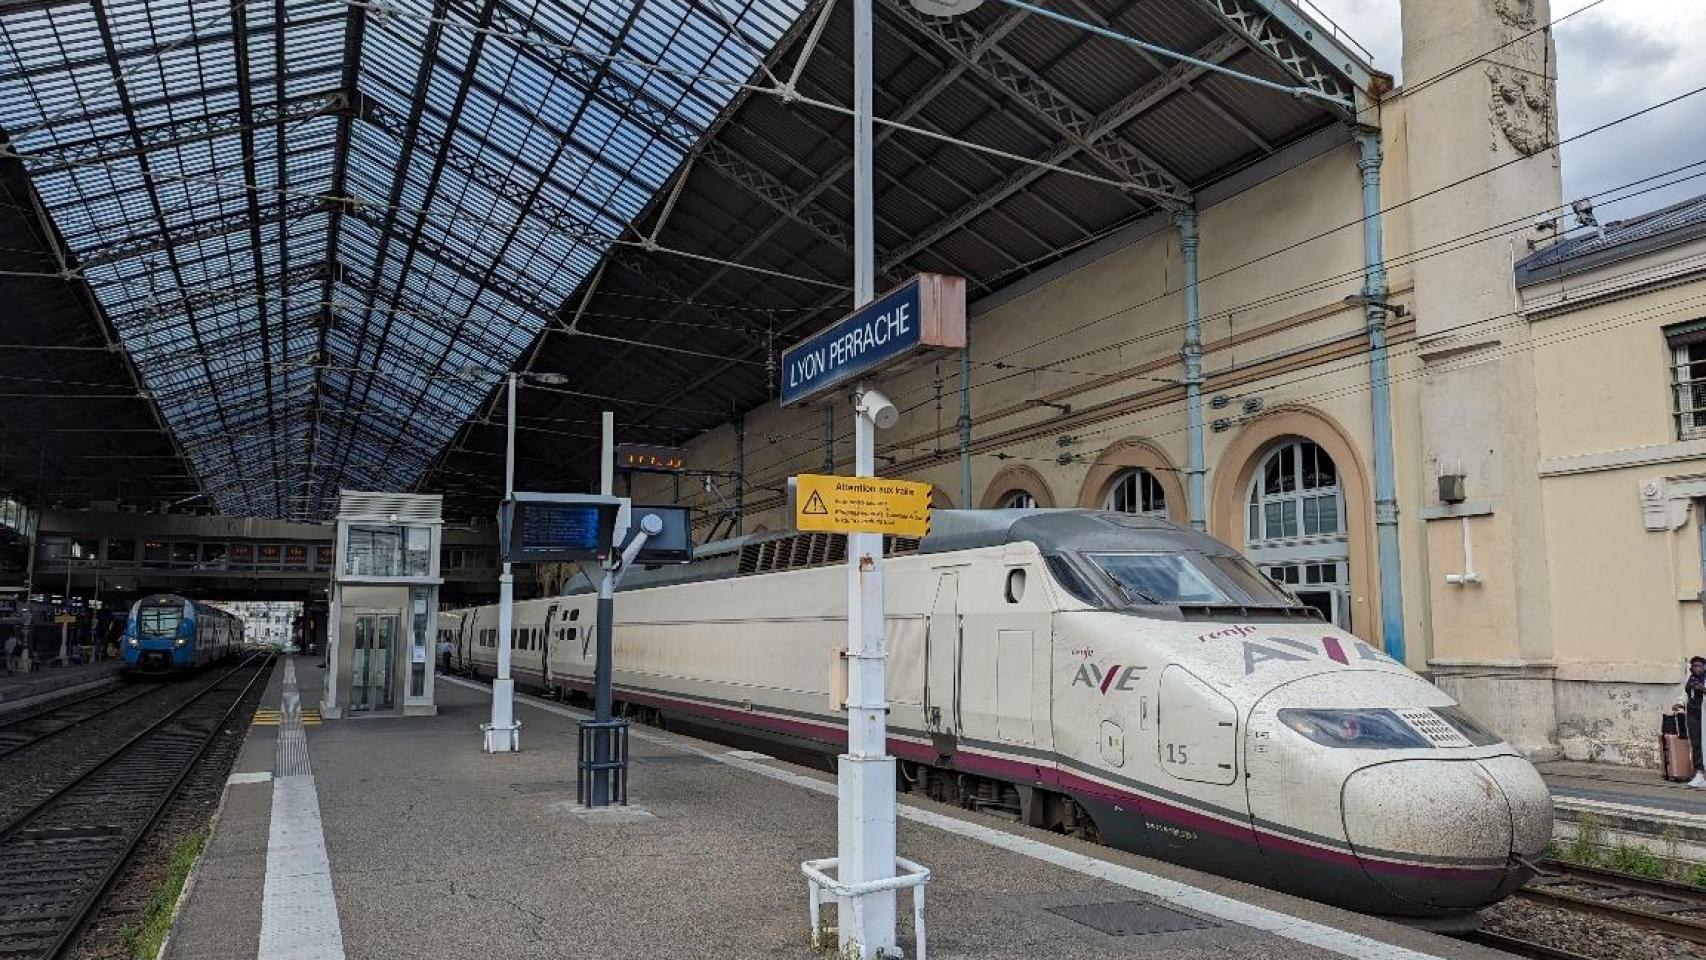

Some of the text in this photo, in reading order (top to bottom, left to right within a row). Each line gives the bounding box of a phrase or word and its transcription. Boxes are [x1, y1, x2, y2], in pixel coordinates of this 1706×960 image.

[790, 303, 910, 388] LYON PERRACHE
[835, 482, 876, 493] Attention
[878, 486, 894, 495] aux
[1198, 624, 1257, 644] renfe
[1071, 663, 1148, 696] AVE
[1166, 743, 1188, 765] 15
